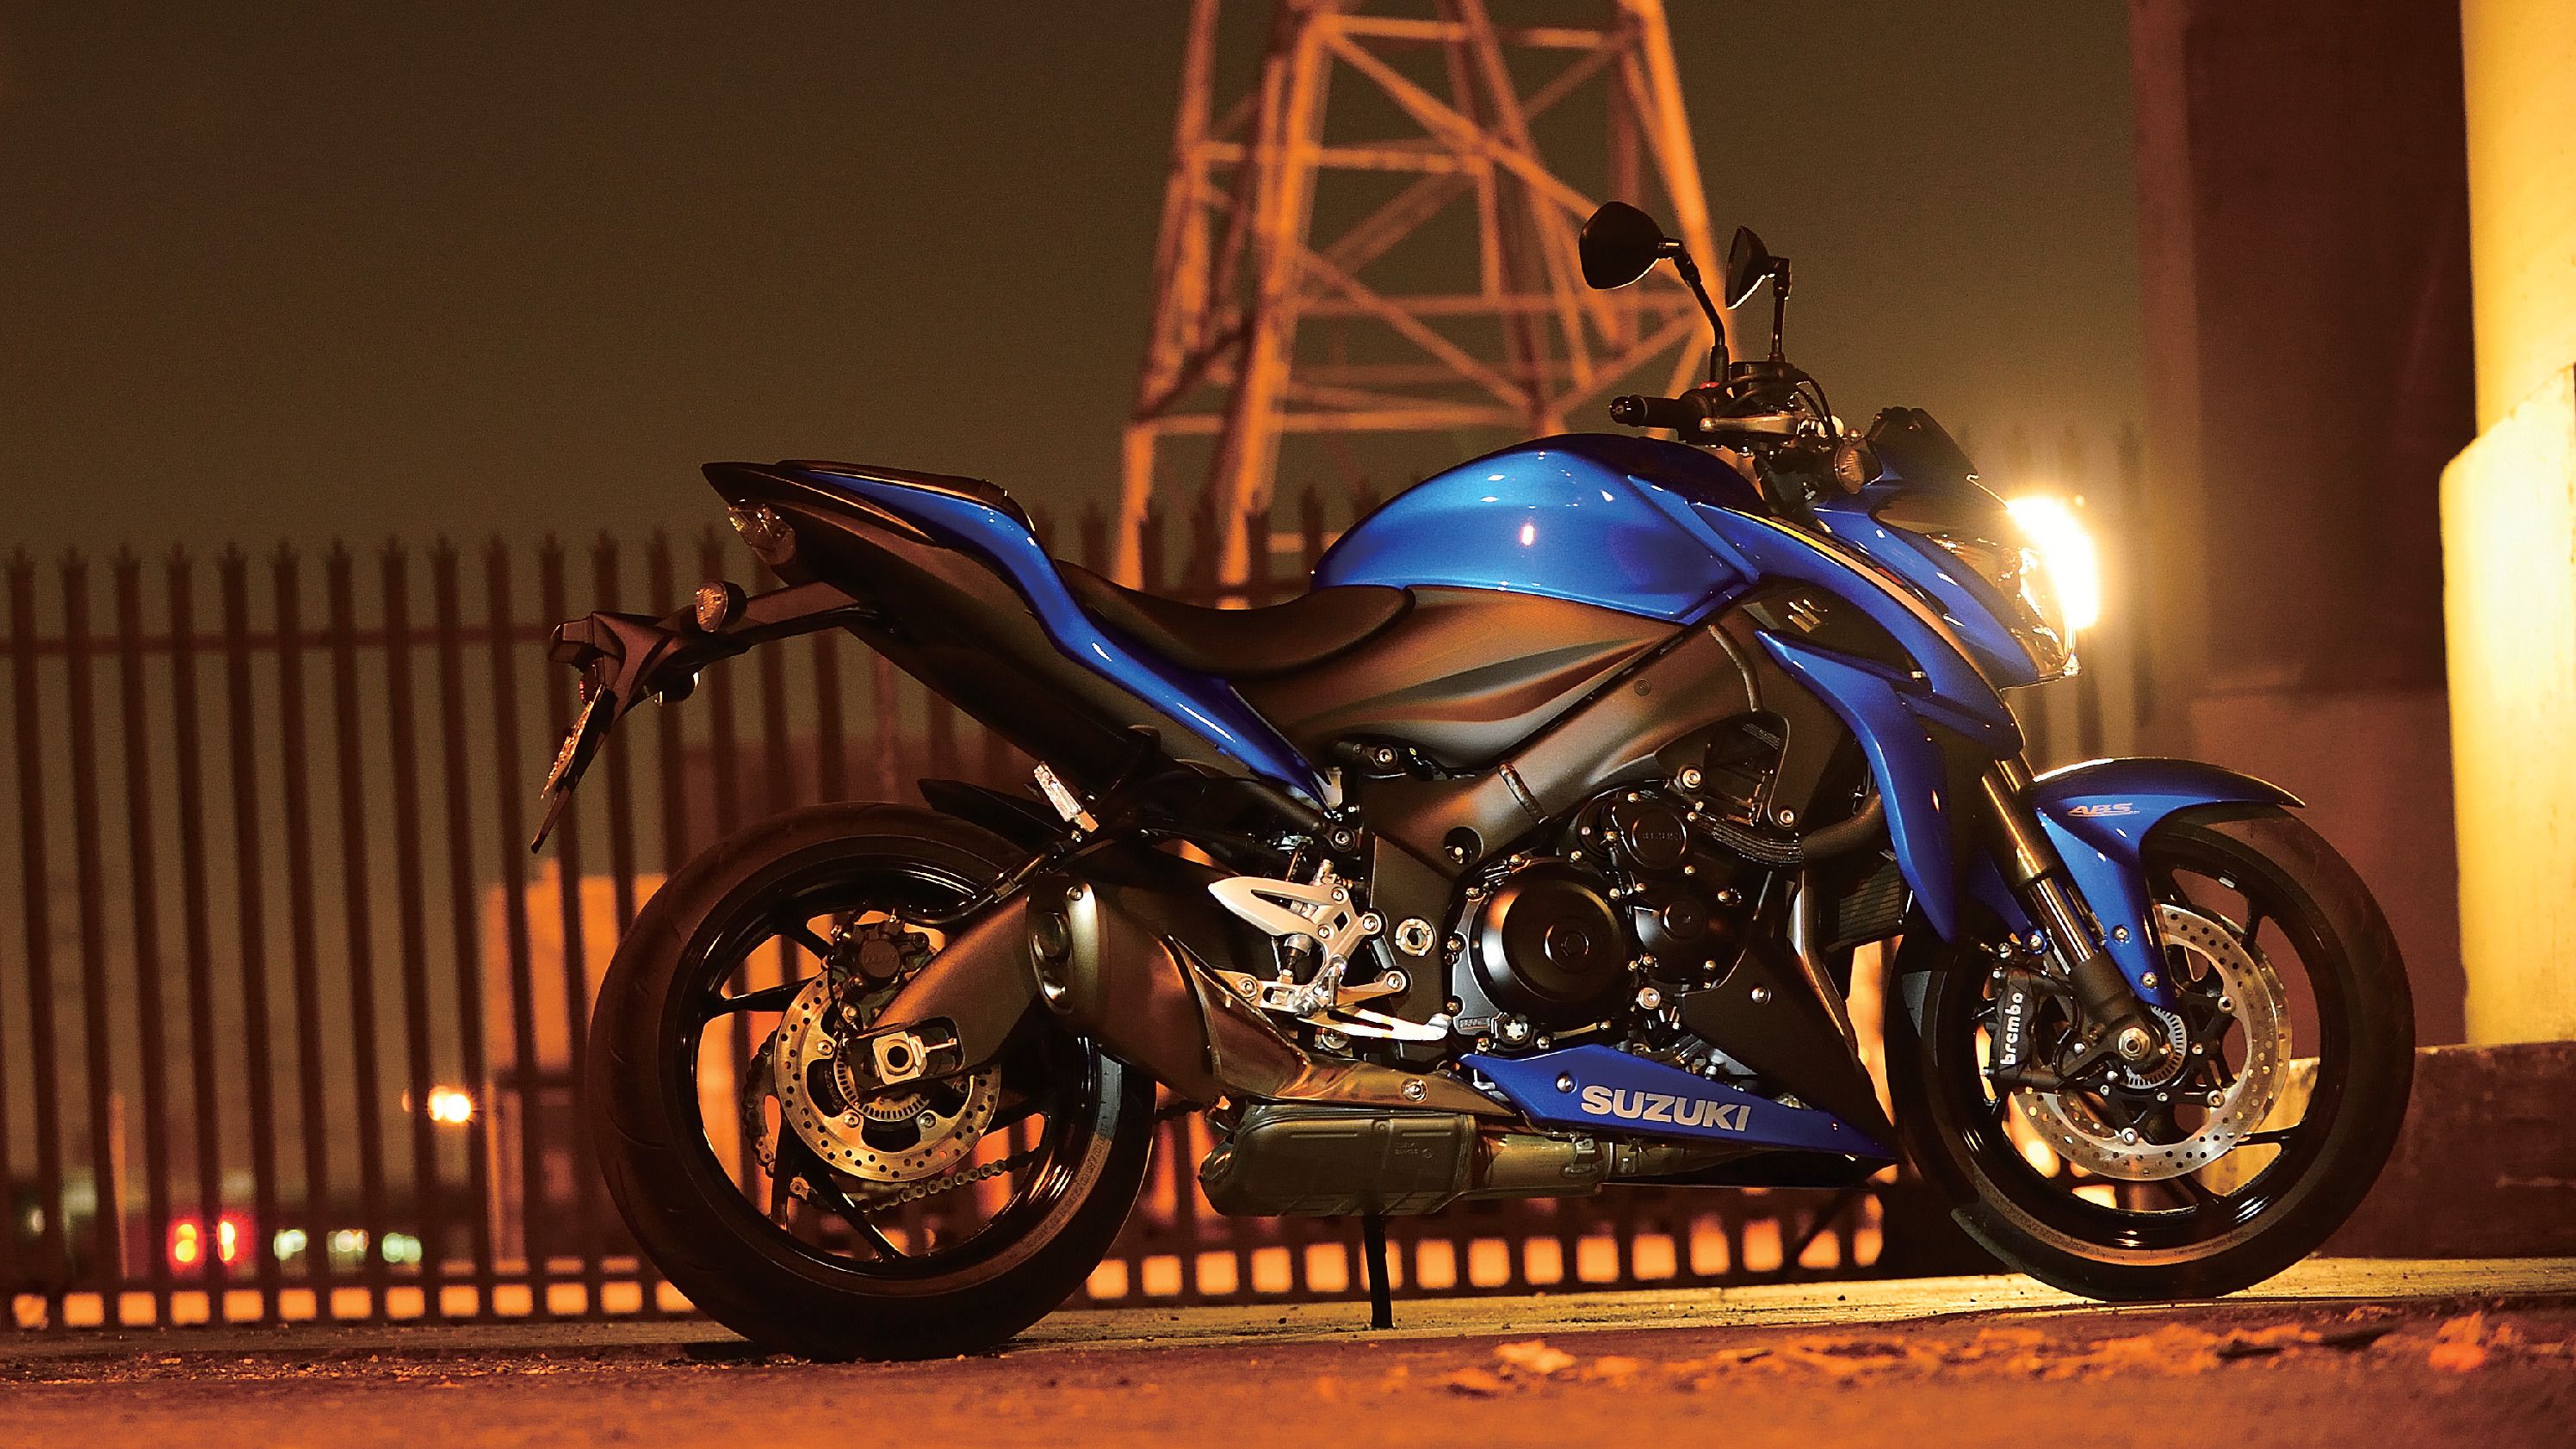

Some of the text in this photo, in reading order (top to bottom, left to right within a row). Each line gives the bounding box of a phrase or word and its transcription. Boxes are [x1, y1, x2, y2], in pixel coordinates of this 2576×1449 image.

[2067, 802, 2133, 816] ABS
[1999, 992, 2023, 1065] brembo
[1581, 1085, 1751, 1131] SUZUKI
